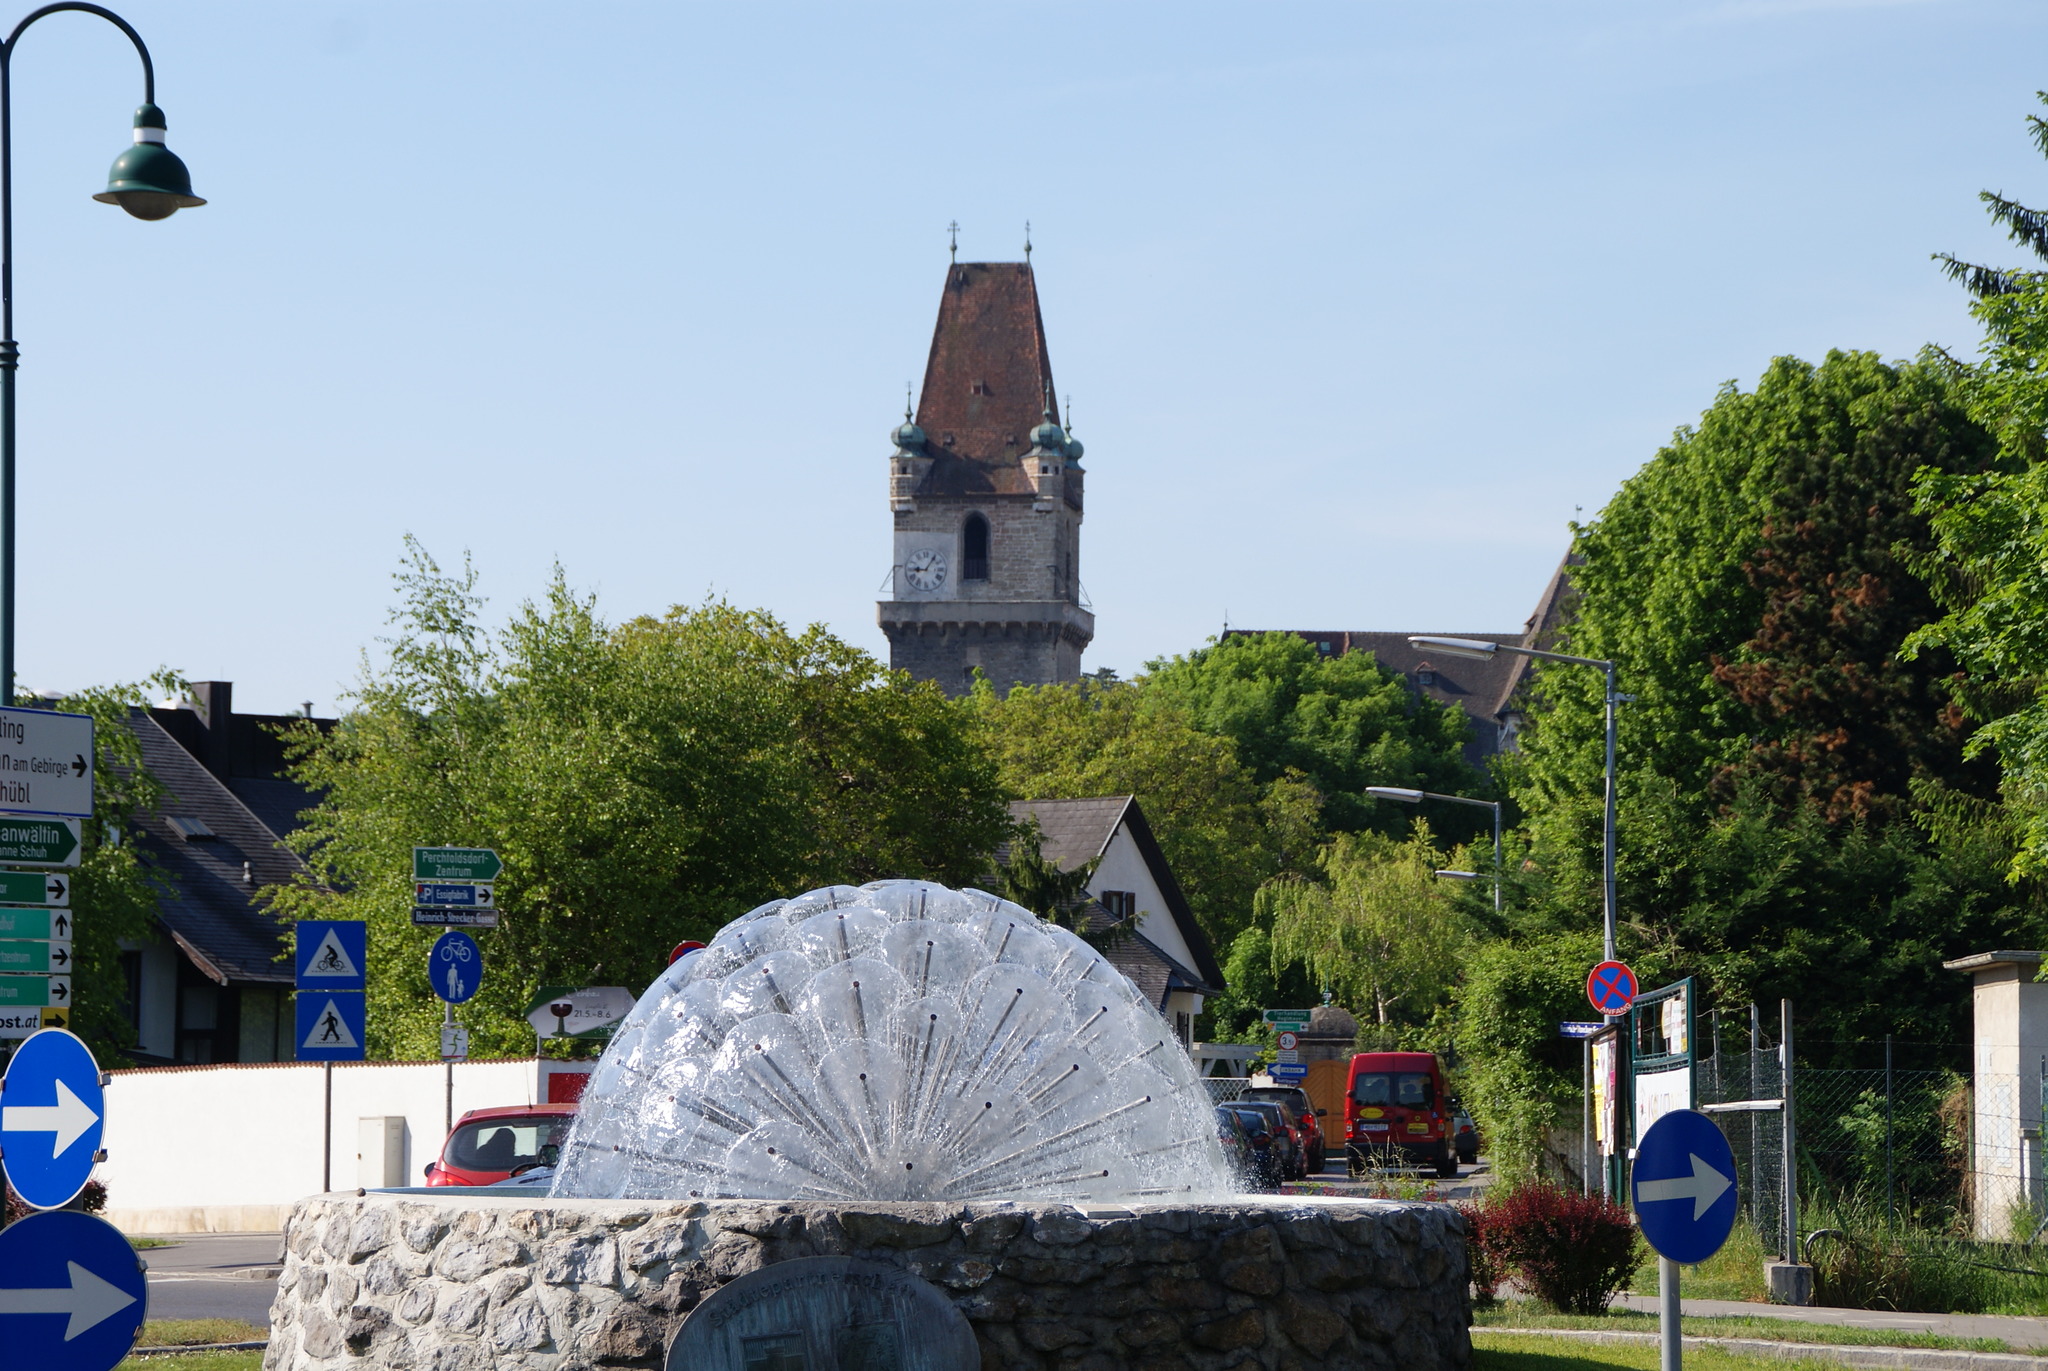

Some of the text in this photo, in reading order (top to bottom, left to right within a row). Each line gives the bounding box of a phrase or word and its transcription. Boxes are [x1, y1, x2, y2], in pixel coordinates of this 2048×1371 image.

[13, 758, 28, 772] am
[31, 756, 68, 778] Gebirge
[0, 824, 60, 845] anwältin
[20, 844, 48, 858] Schuh
[422, 850, 489, 865] Perchtoldsdorf-
[435, 864, 472, 877] Zentrum
[436, 888, 469, 902] Essigfabrik
[415, 910, 496, 924] Heinrich-Strecker-Gasse
[1600, 1002, 1632, 1015] ANFANG
